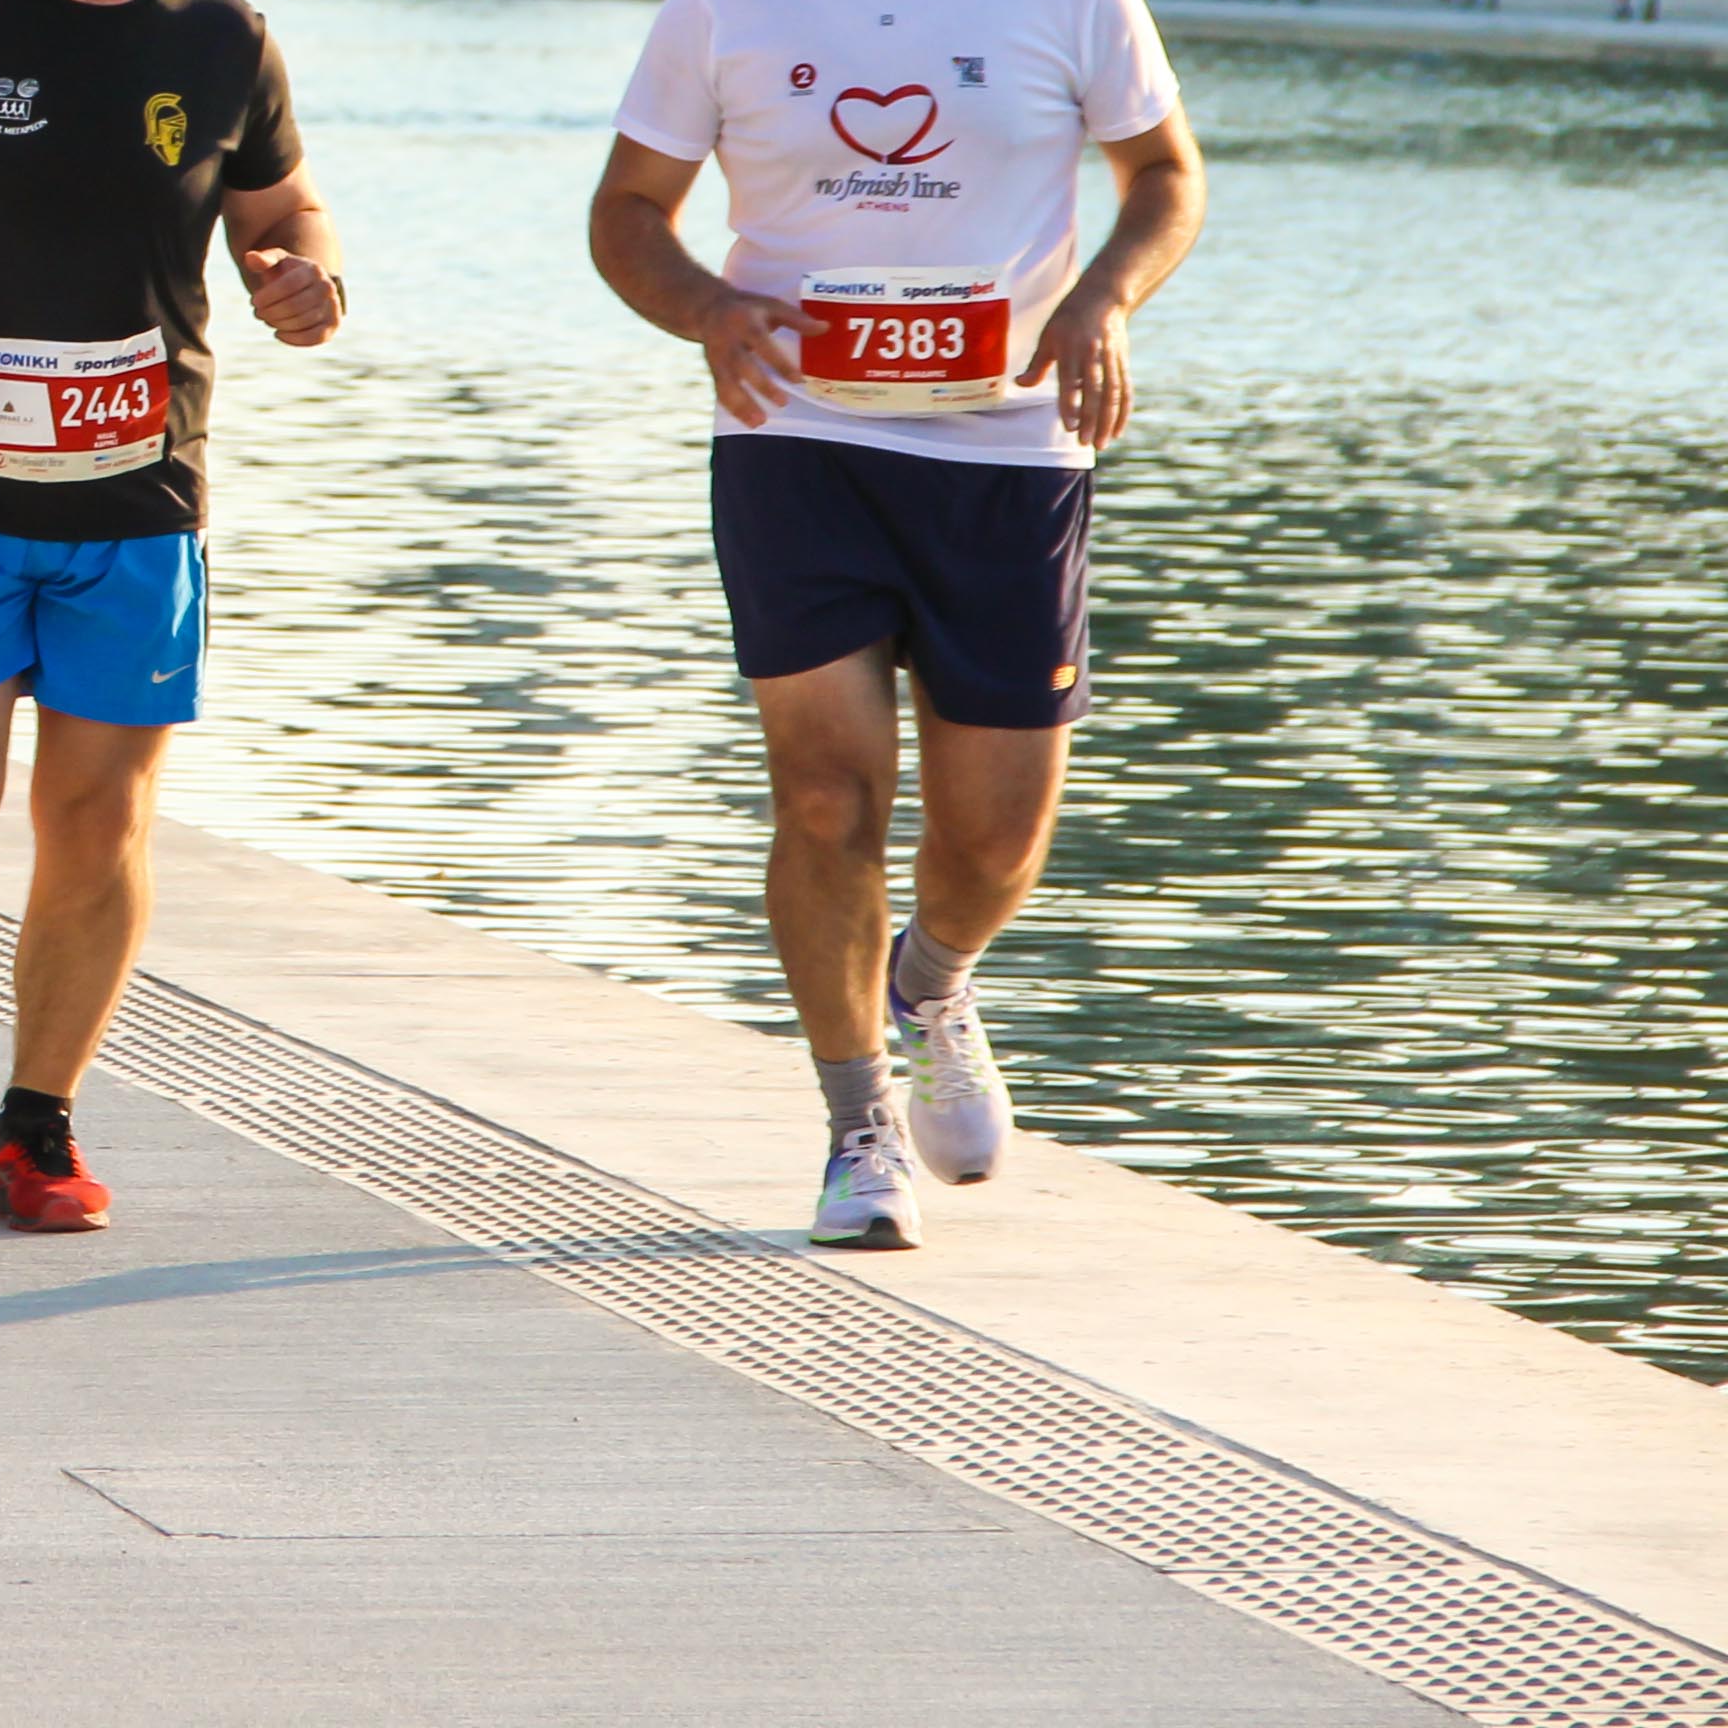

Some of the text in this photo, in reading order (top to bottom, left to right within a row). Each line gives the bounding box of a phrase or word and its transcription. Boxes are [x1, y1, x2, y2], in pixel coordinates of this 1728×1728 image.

[798, 68, 811, 84] 2
[815, 170, 961, 201] no finish line
[855, 201, 910, 212] ATHENS
[902, 280, 996, 299] sportingbet
[848, 317, 965, 360] 7383
[74, 346, 157, 372] sportingbet
[60, 377, 150, 428] 2443
